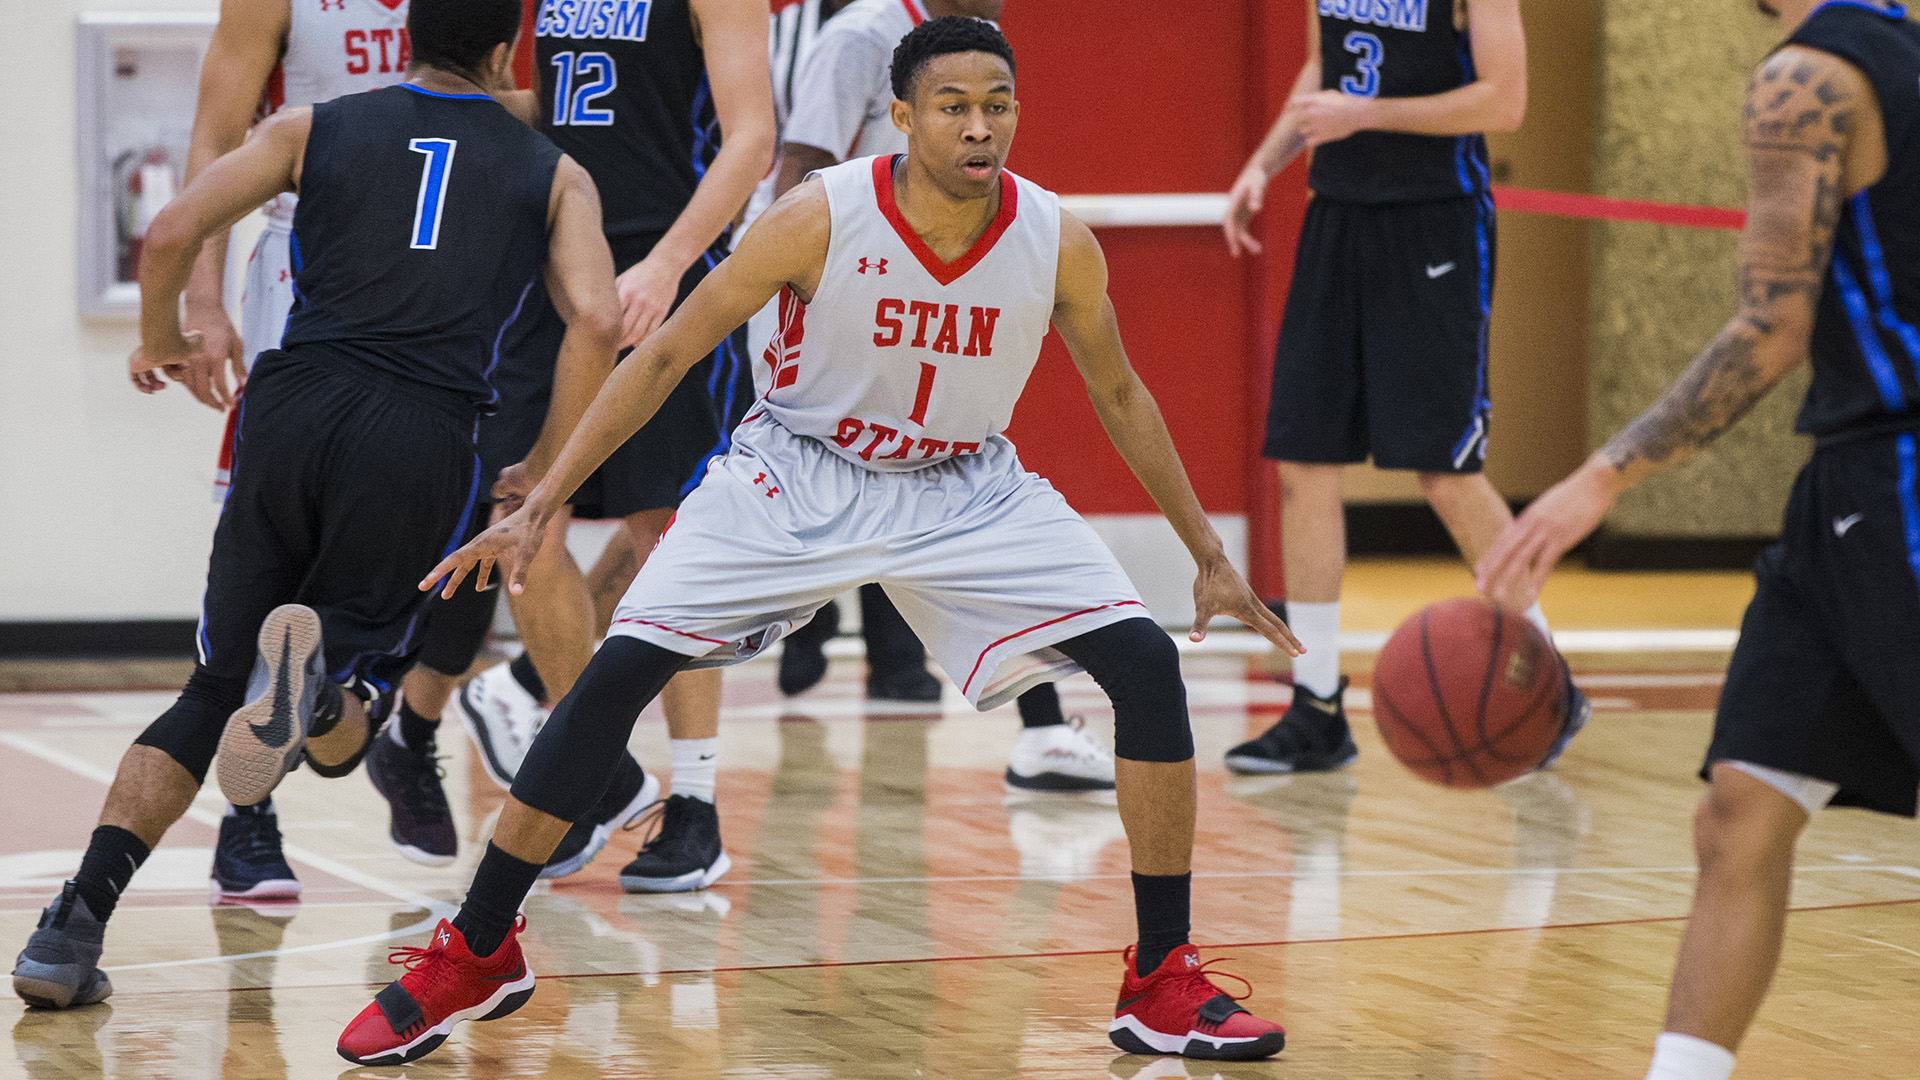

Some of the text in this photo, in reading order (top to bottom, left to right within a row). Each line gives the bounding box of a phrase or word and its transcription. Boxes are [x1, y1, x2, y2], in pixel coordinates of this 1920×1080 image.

[535, 0, 652, 42] CSUSM
[551, 51, 617, 126] 12
[1339, 30, 1384, 99] 3
[408, 138, 457, 249] 1
[873, 298, 1000, 357] STAN
[907, 361, 937, 427] 1
